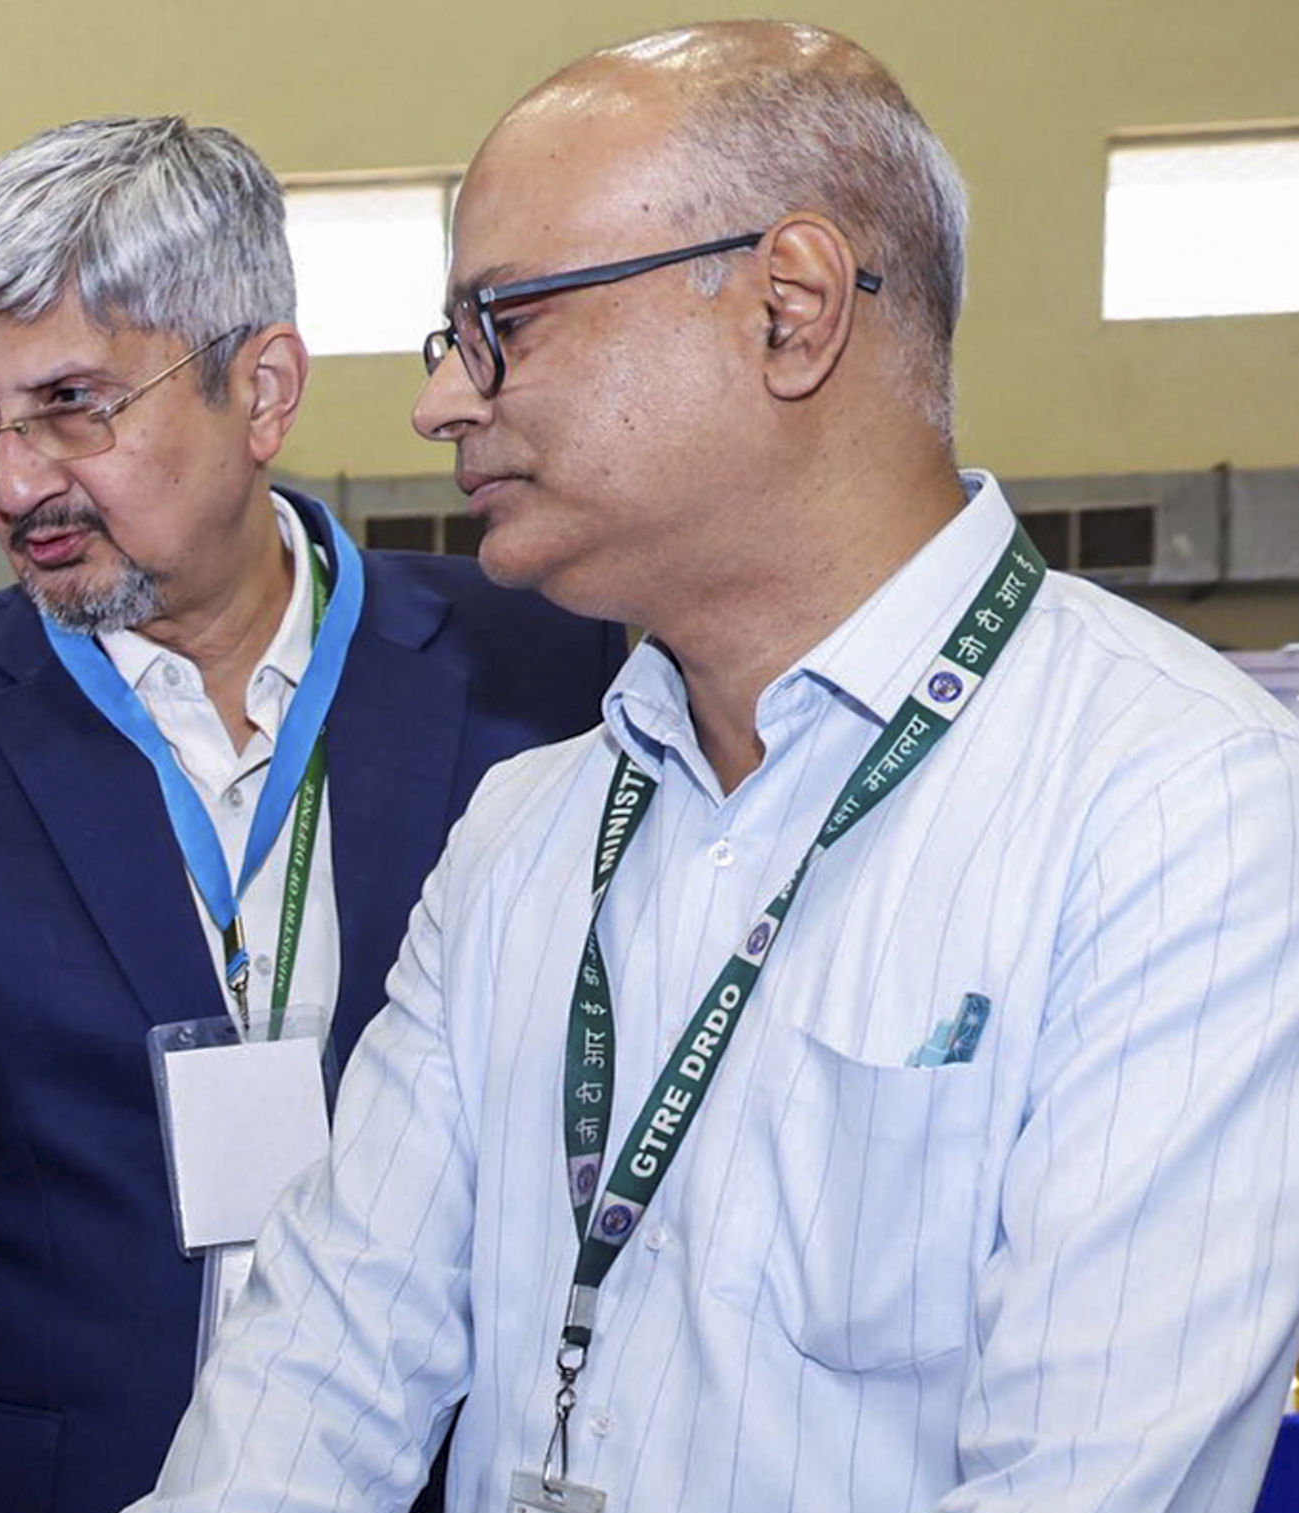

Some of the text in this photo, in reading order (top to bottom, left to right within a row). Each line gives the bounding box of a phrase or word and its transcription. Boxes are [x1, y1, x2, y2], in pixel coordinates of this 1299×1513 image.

[995, 571, 1027, 609] आर
[862, 713, 931, 792] मंत्रालय
[597, 760, 646, 875] MINIST
[583, 1028, 606, 1069] आर
[630, 984, 741, 1179] GTRE DRDO
